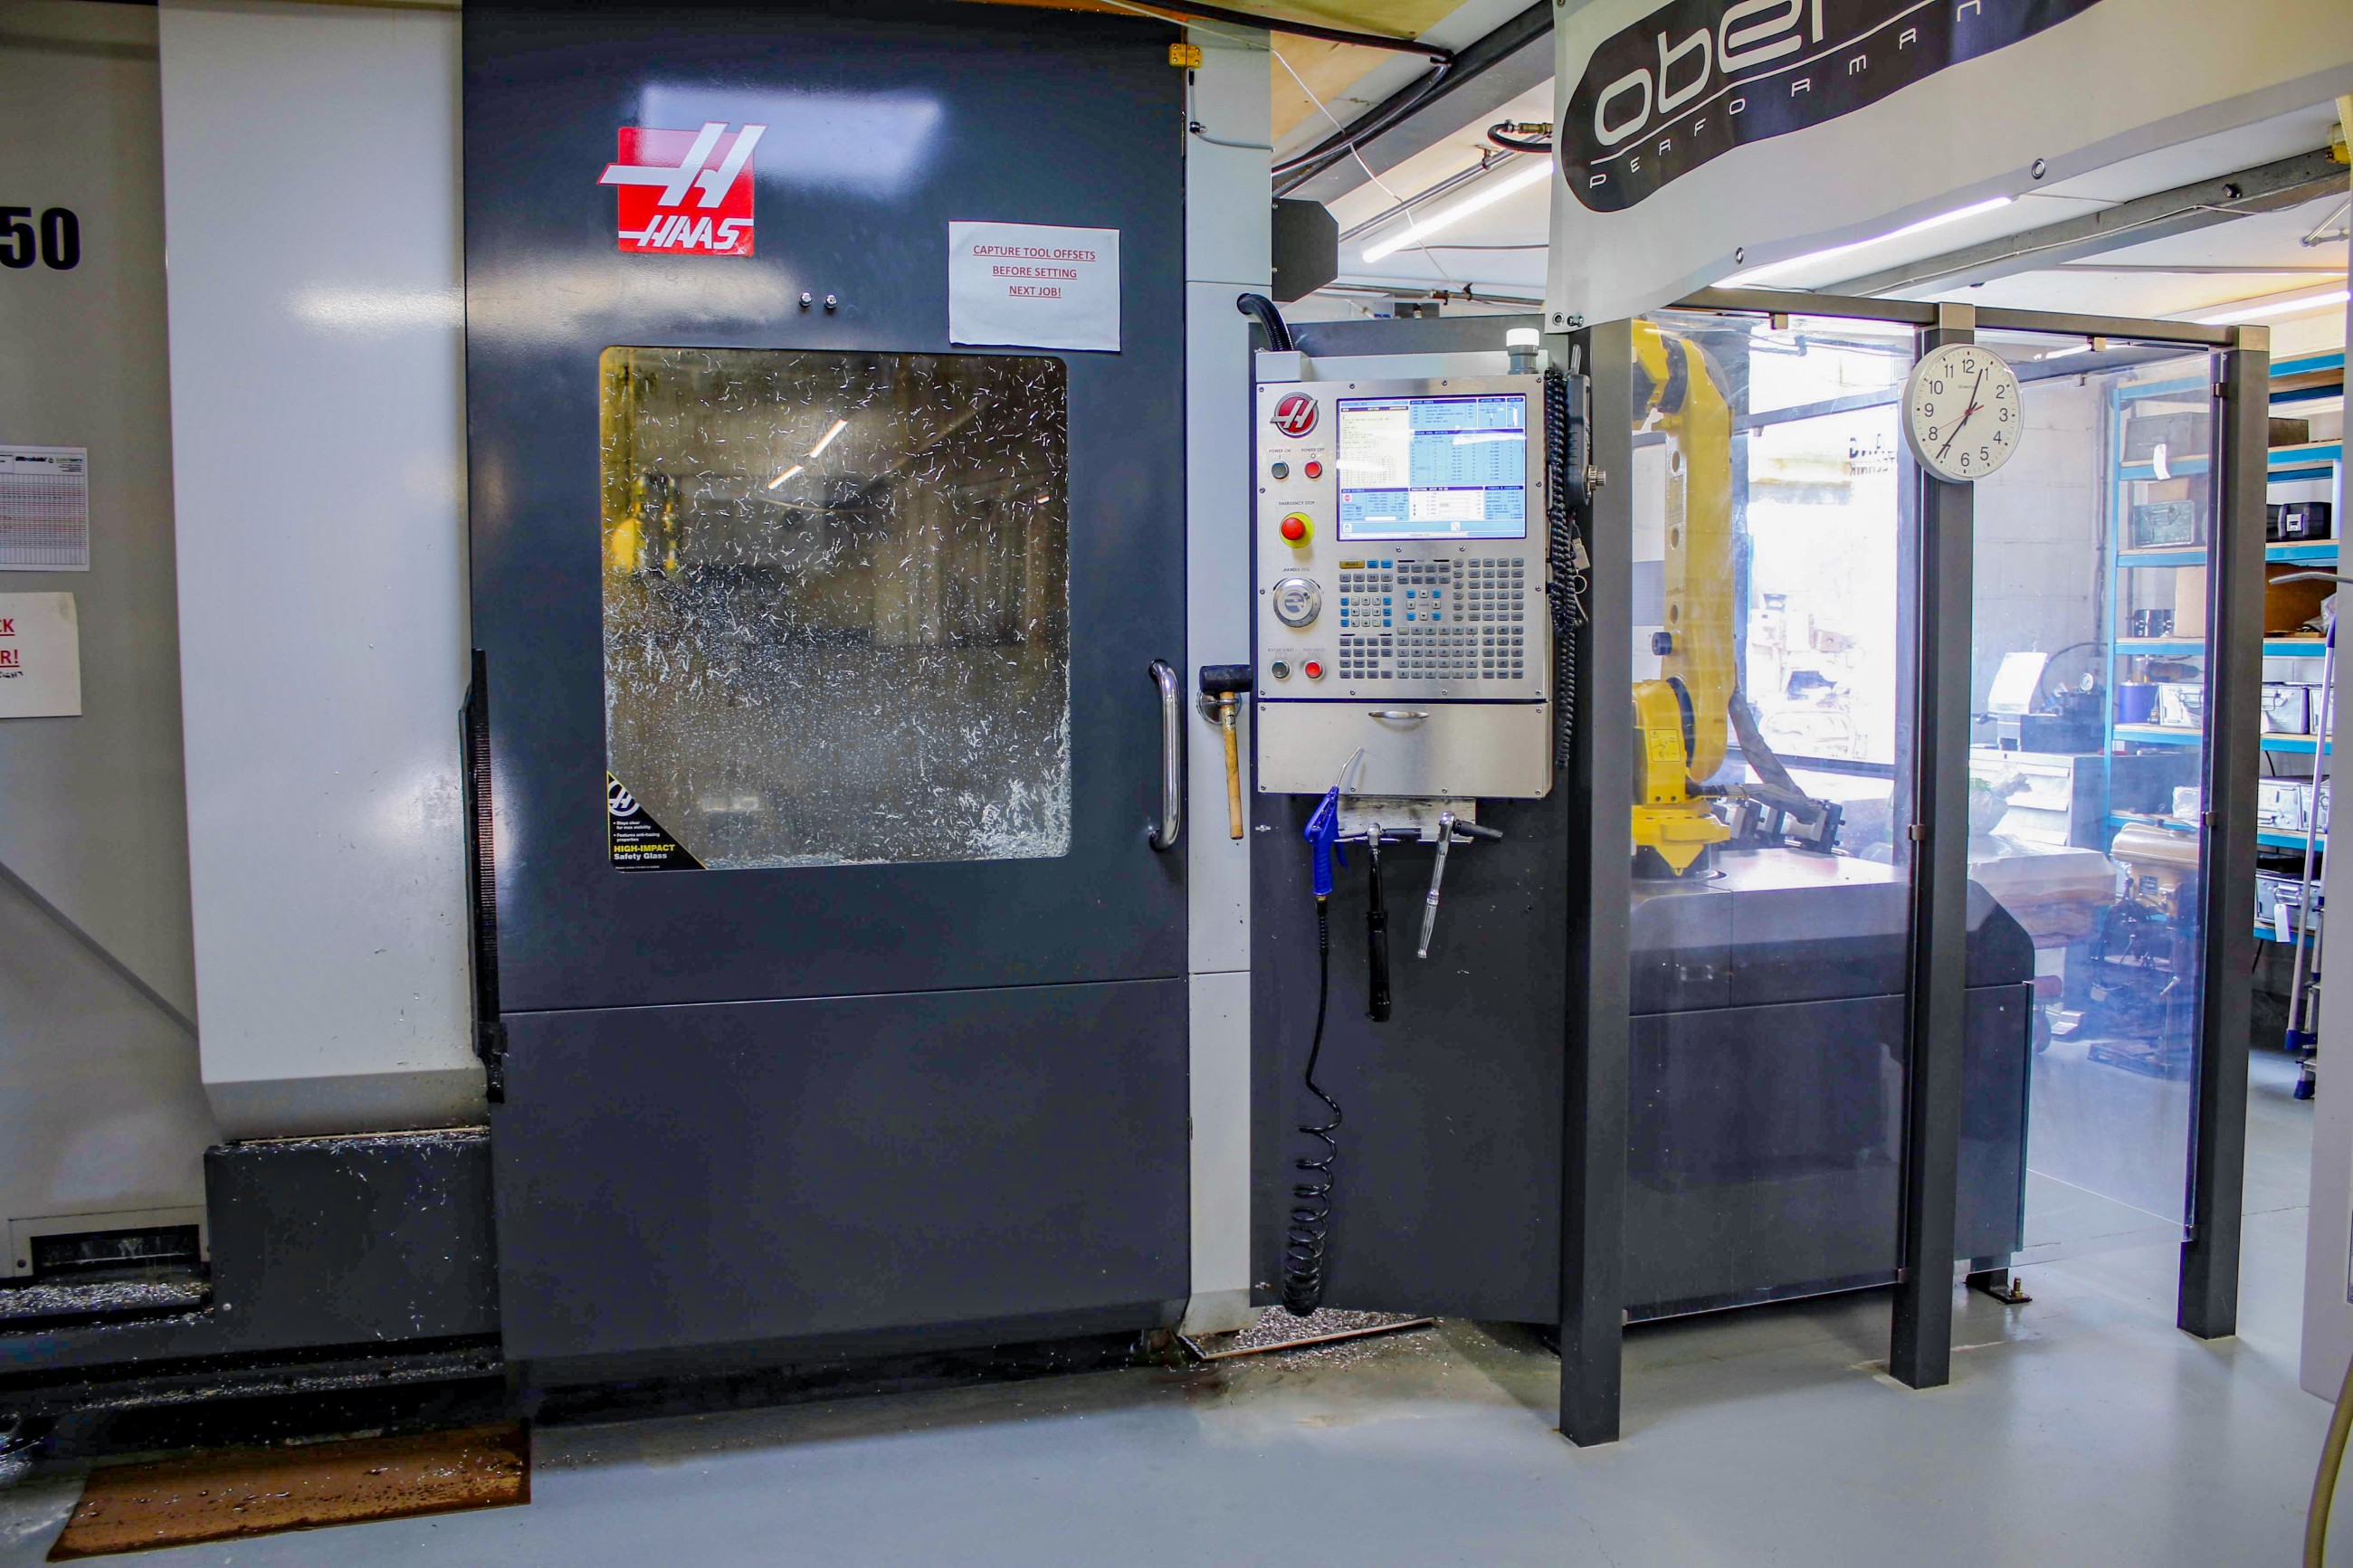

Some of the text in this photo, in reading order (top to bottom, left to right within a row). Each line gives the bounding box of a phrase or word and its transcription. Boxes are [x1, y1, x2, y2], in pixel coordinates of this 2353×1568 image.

[618, 214, 754, 251] HAAS
[973, 244, 1096, 261] CAPTURE TOOL OFFSETS
[992, 265, 1078, 278] BEFORE SETTING
[1009, 285, 1062, 297] NEXT JOB!
[1944, 364, 1954, 378] 11
[1961, 358, 1976, 374] 12
[1985, 367, 1989, 381] 1
[1929, 380, 1944, 394] 10
[1996, 385, 2005, 399] 2
[1924, 403, 1934, 417] 9
[1999, 407, 2008, 422] 3
[1928, 426, 1939, 441] 8
[1993, 430, 2003, 444] 4
[1942, 443, 1951, 459] 7
[1979, 446, 1989, 461] 5
[1960, 452, 1970, 467] 6
[613, 843, 676, 853] HIGH-IMPACT
[614, 852, 642, 861] Safety
